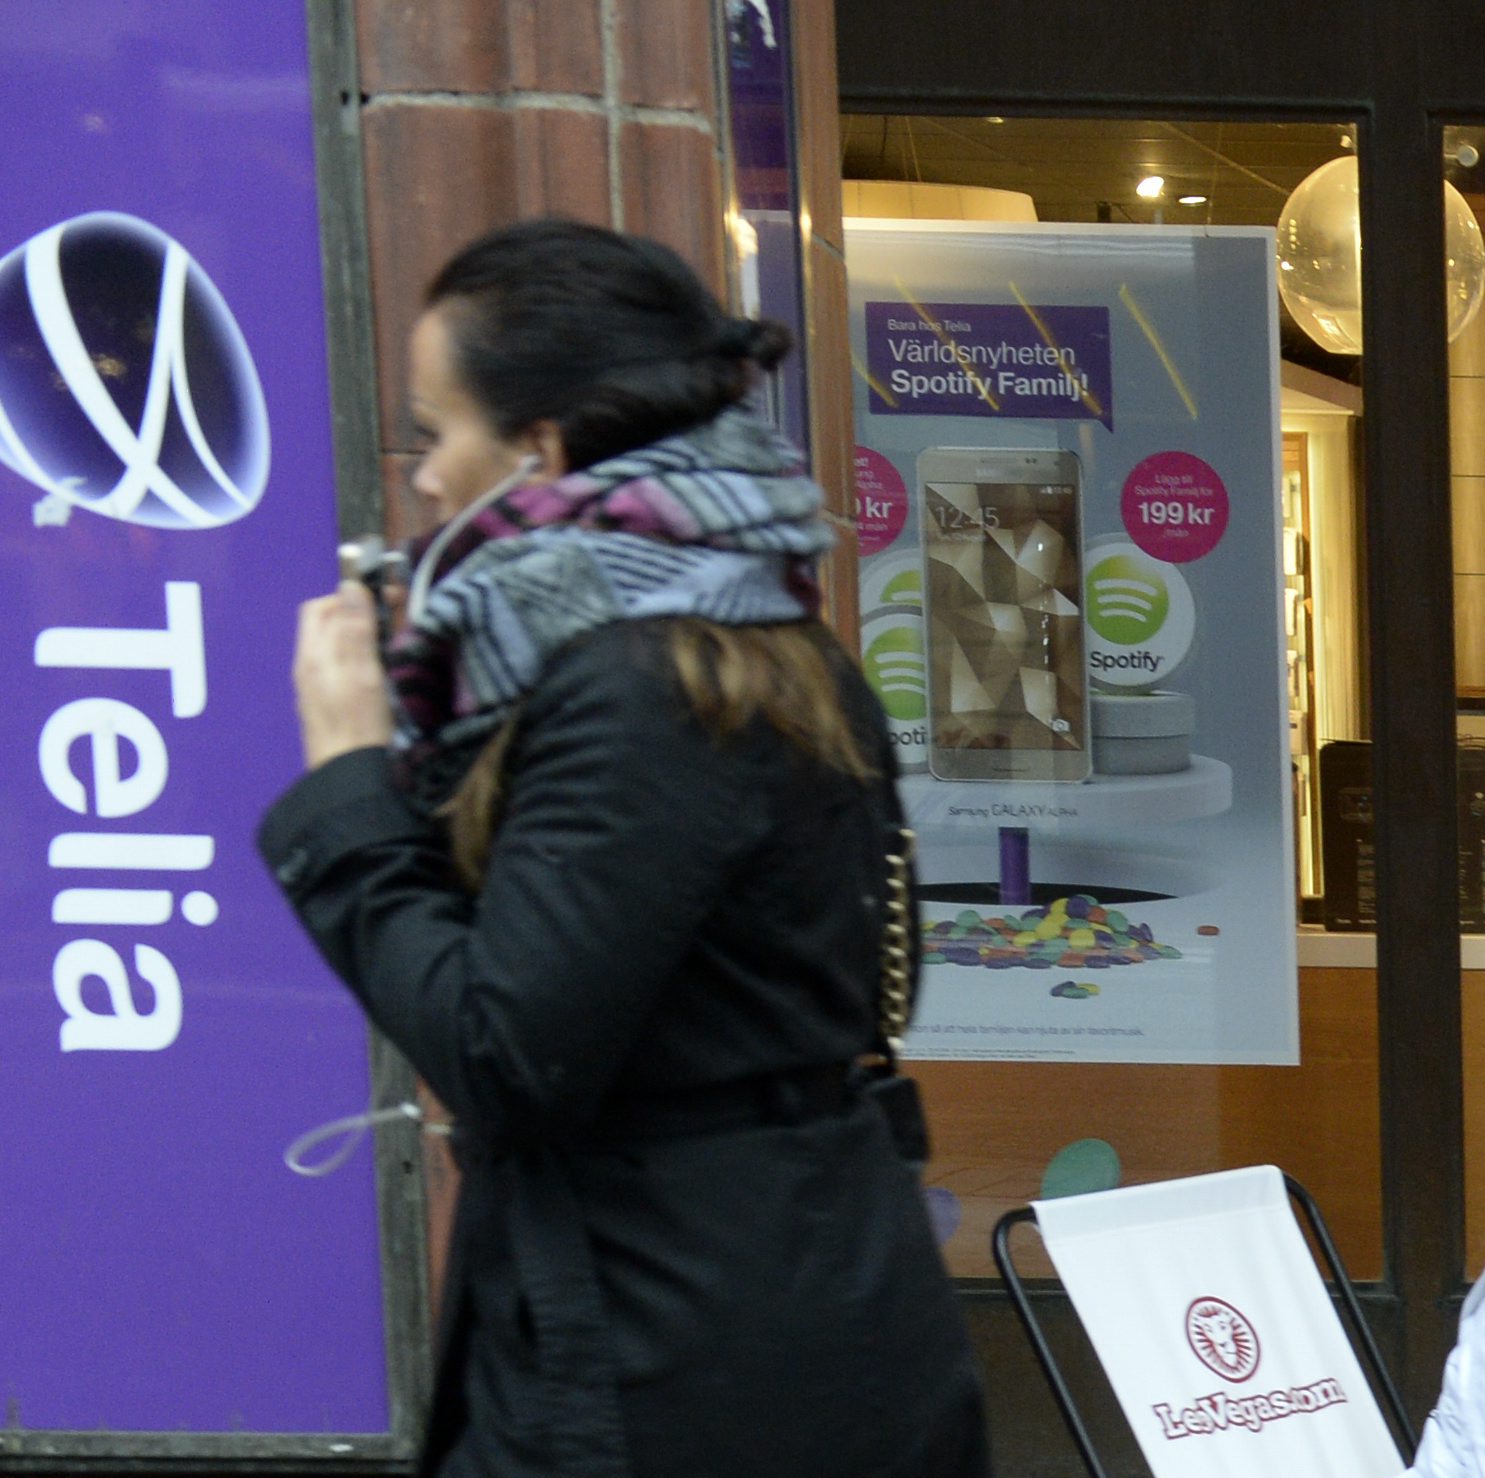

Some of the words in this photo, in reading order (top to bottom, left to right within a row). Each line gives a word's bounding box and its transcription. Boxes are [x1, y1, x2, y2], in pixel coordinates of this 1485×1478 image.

[887, 318, 916, 331] Bara
[944, 319, 972, 332] Telia
[888, 338, 1076, 370] Världsnyheten
[891, 369, 992, 400] Spotify
[998, 371, 1089, 402] Familj!
[865, 496, 894, 518] kr
[1137, 501, 1185, 525] 199
[1187, 502, 1216, 525] kr
[1089, 651, 1161, 673] Spotify
[32, 580, 220, 1052] Telia
[991, 804, 1044, 816] GALAXY
